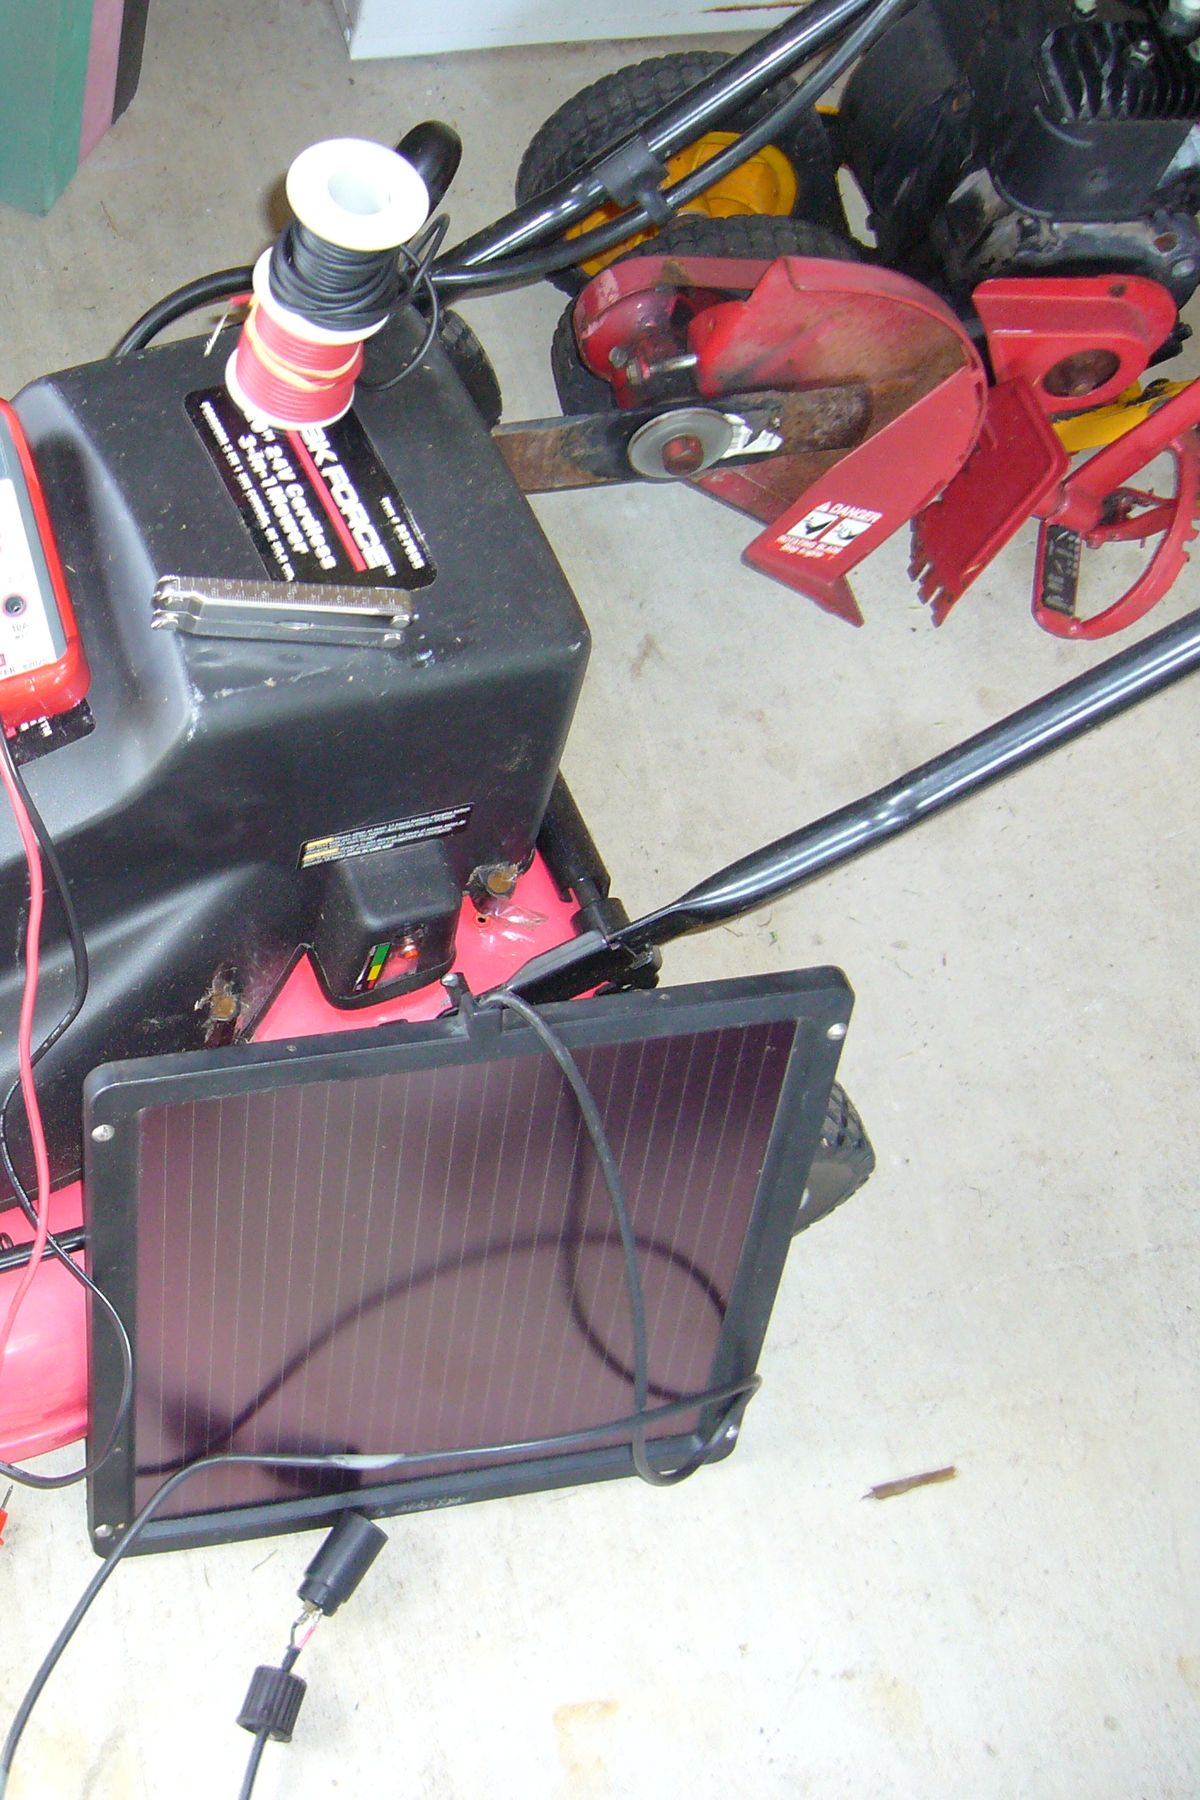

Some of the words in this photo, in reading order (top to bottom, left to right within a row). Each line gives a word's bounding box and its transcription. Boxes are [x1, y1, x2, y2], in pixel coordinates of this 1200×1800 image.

[264, 445, 297, 481] 24V
[285, 483, 337, 570] Cordless
[264, 486, 309, 555] Mower
[828, 503, 883, 524] DANGER
